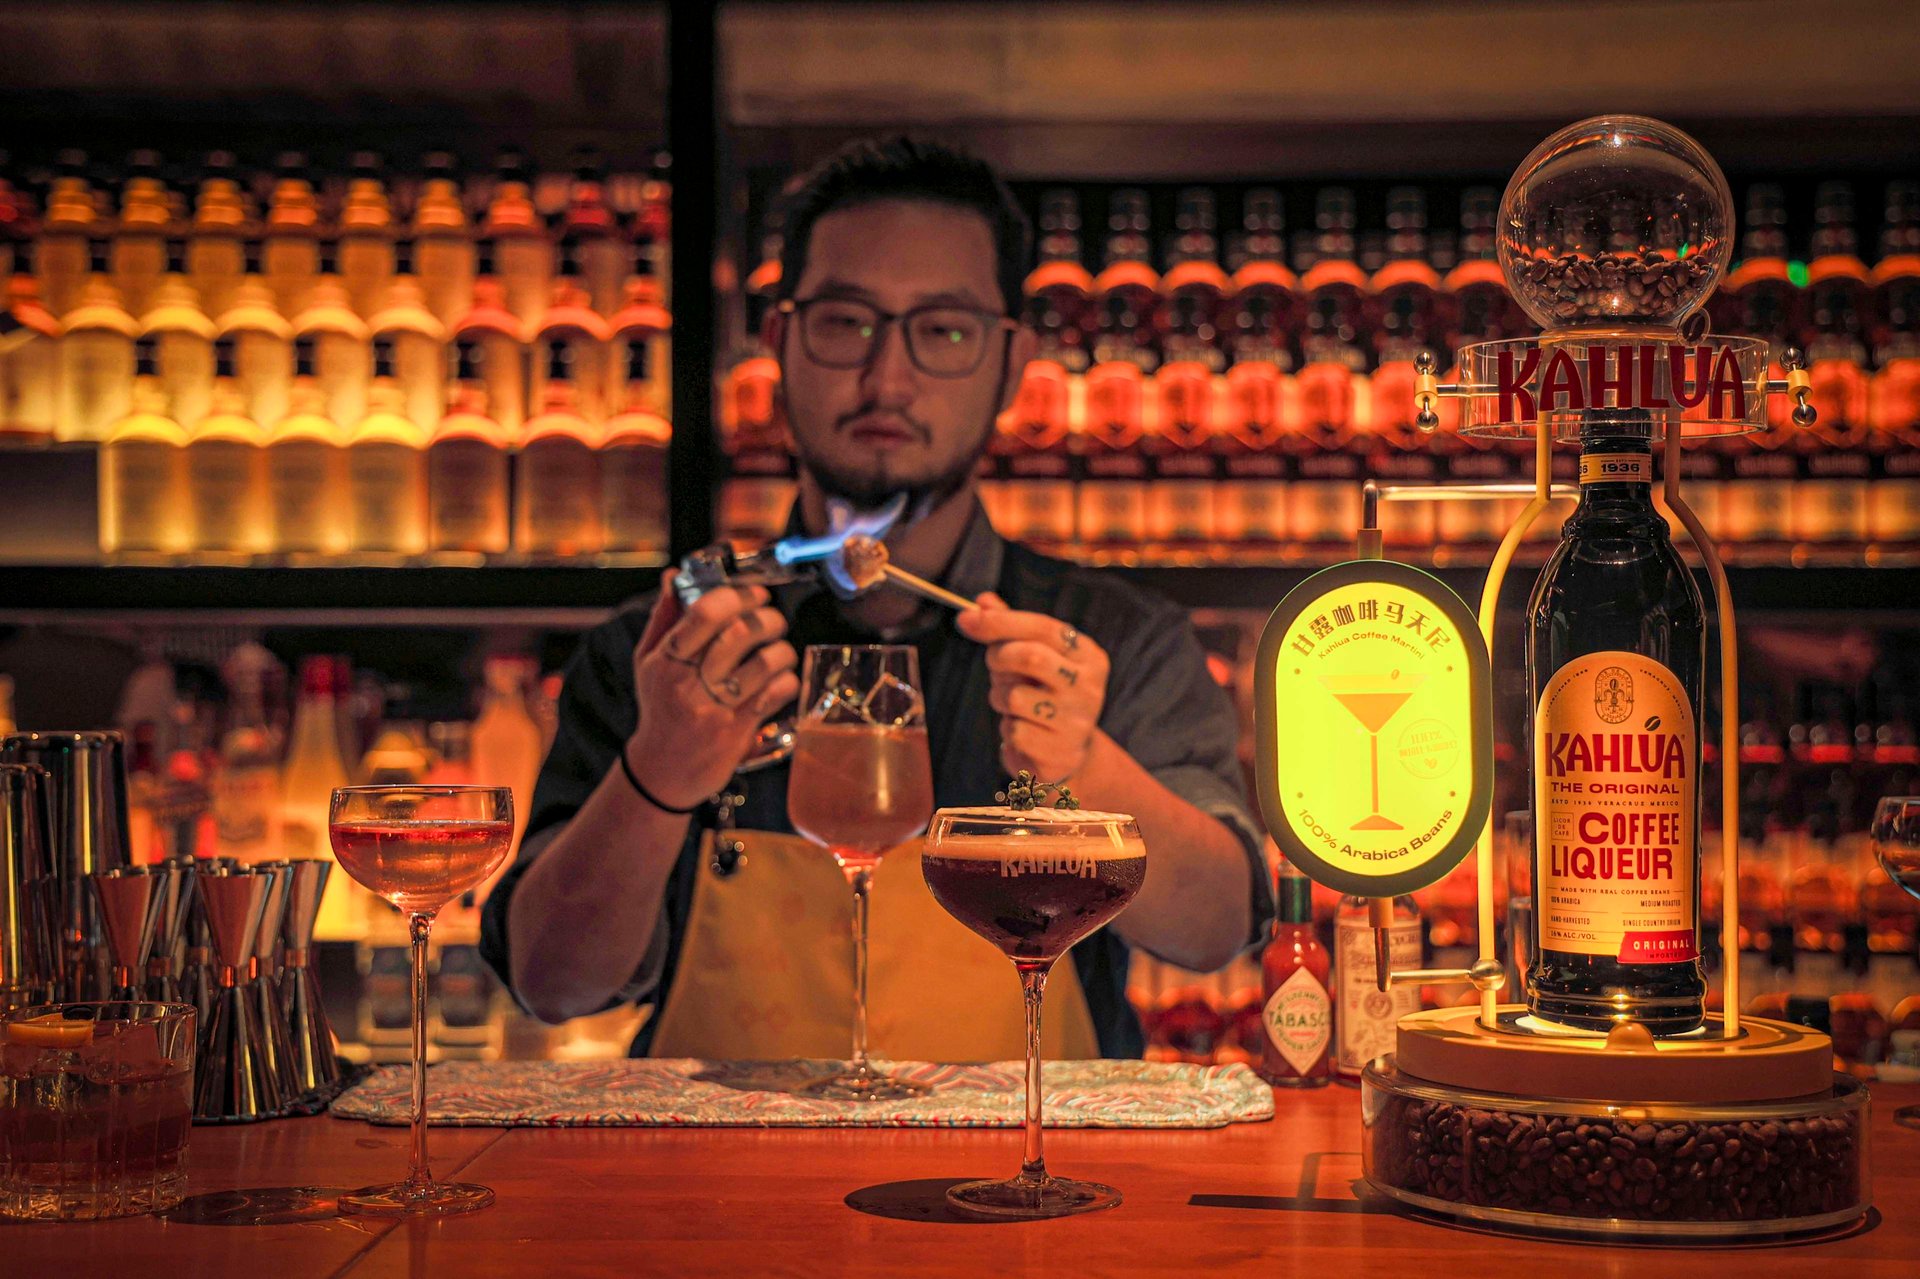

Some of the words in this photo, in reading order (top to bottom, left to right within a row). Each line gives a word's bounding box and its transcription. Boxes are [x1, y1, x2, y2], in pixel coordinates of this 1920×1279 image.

[1601, 463, 1640, 473] 1936
[1291, 599, 1451, 657] 甘露咖啡马天尼
[1318, 636, 1350, 660] Kahlua
[1352, 631, 1388, 641] Coffee
[1390, 635, 1425, 660] Martini
[1551, 782, 1583, 793] THE
[1589, 783, 1680, 794] ORIGINAL
[1299, 808, 1337, 849] 100%
[1340, 844, 1409, 861] Arabica
[1409, 809, 1453, 850] Beans
[1578, 812, 1680, 845] COFFEE
[1551, 845, 1673, 880] LIQUEUR
[1643, 919, 1666, 927] COUNTRY
[1633, 939, 1690, 951] ORIGINAL
